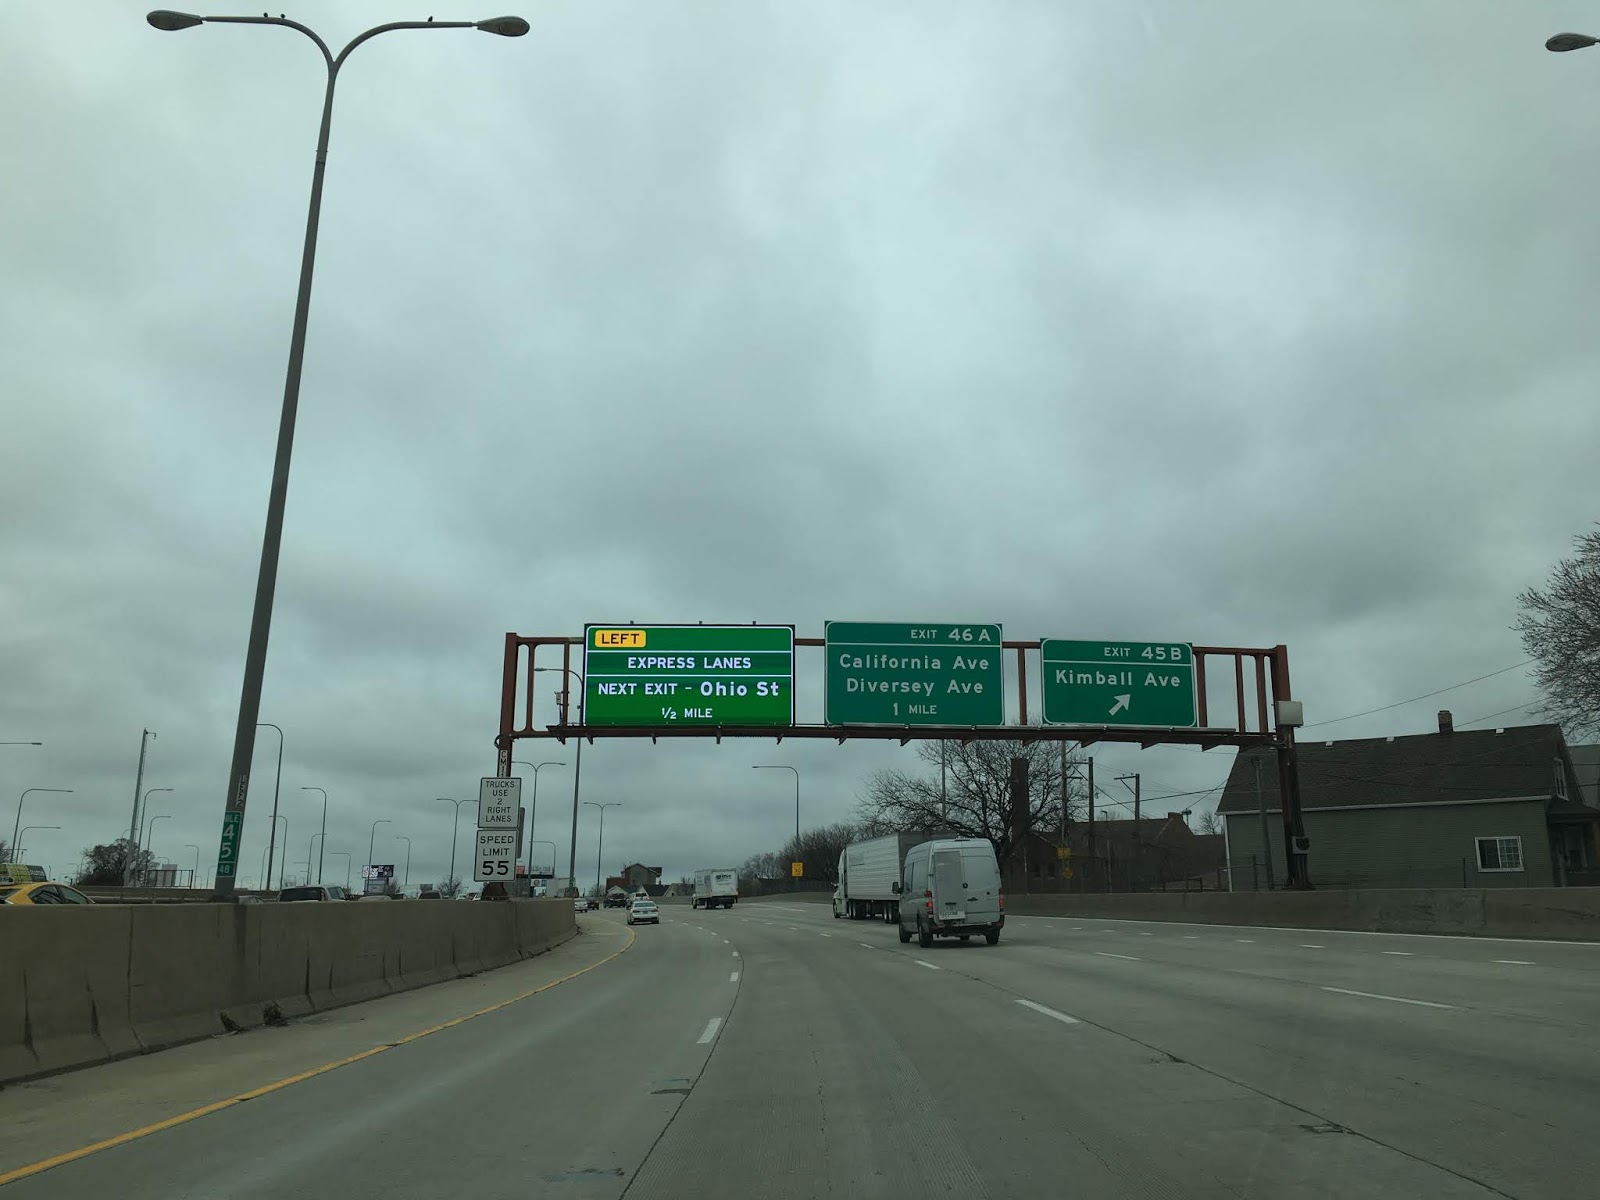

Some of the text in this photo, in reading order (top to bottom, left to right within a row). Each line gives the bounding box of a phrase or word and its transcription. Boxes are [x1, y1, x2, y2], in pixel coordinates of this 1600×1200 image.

[601, 633, 640, 644] LEFT
[911, 628, 990, 642] EXIT 46 A
[1104, 647, 1131, 657] EXIT
[1141, 646, 1167, 660] 45
[628, 657, 752, 669] EXPRESS LANES
[839, 653, 990, 670] California Ave
[1056, 669, 1181, 687] Kimball Ave
[598, 683, 638, 695] NEXT
[644, 683, 678, 695] EXIT
[700, 681, 748, 696] Ohio
[756, 681, 779, 696] St
[846, 678, 984, 697] Diversey Ave
[684, 708, 713, 718] MILE
[893, 702, 937, 716] 1 MILE
[480, 836, 514, 844] SPEED
[482, 848, 510, 856] LIMIT
[481, 861, 509, 876] 55
